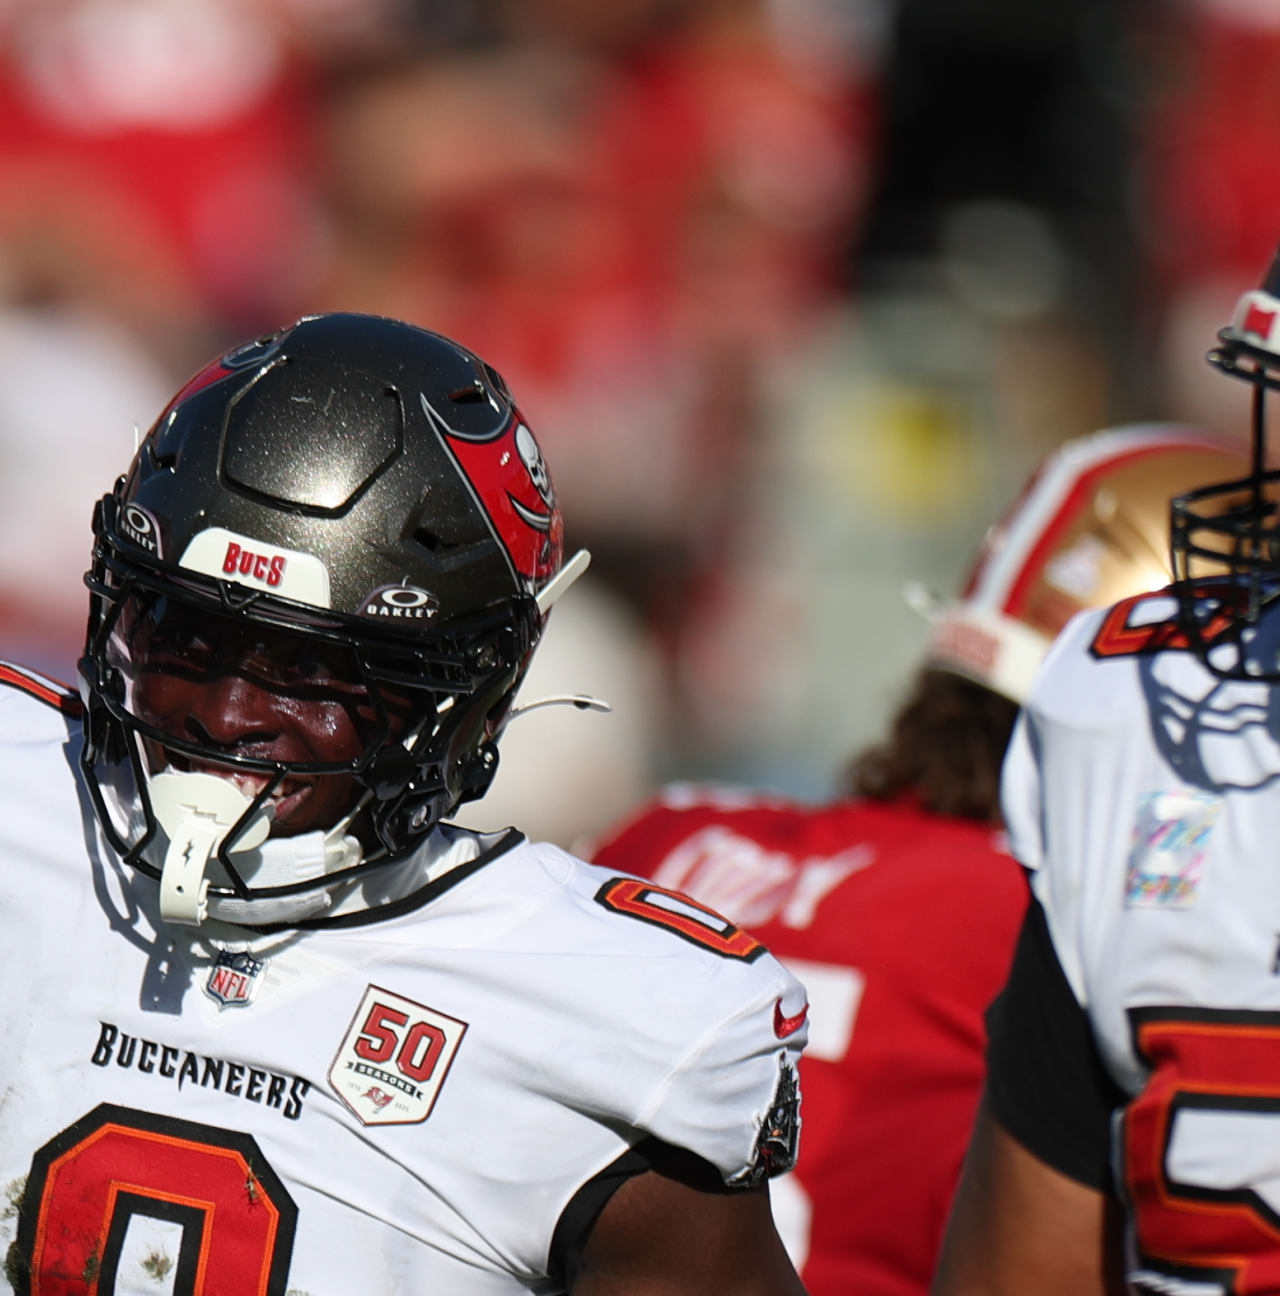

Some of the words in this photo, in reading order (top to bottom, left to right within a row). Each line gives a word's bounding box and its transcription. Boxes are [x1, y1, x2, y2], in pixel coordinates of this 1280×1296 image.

[222, 541, 286, 587] BUCS
[366, 604, 436, 618] OAKLEY
[211, 967, 250, 1001] NFL
[354, 1002, 447, 1083] 50
[91, 1020, 312, 1121] BUCCANEERS
[357, 1064, 414, 1094] SEASONS
